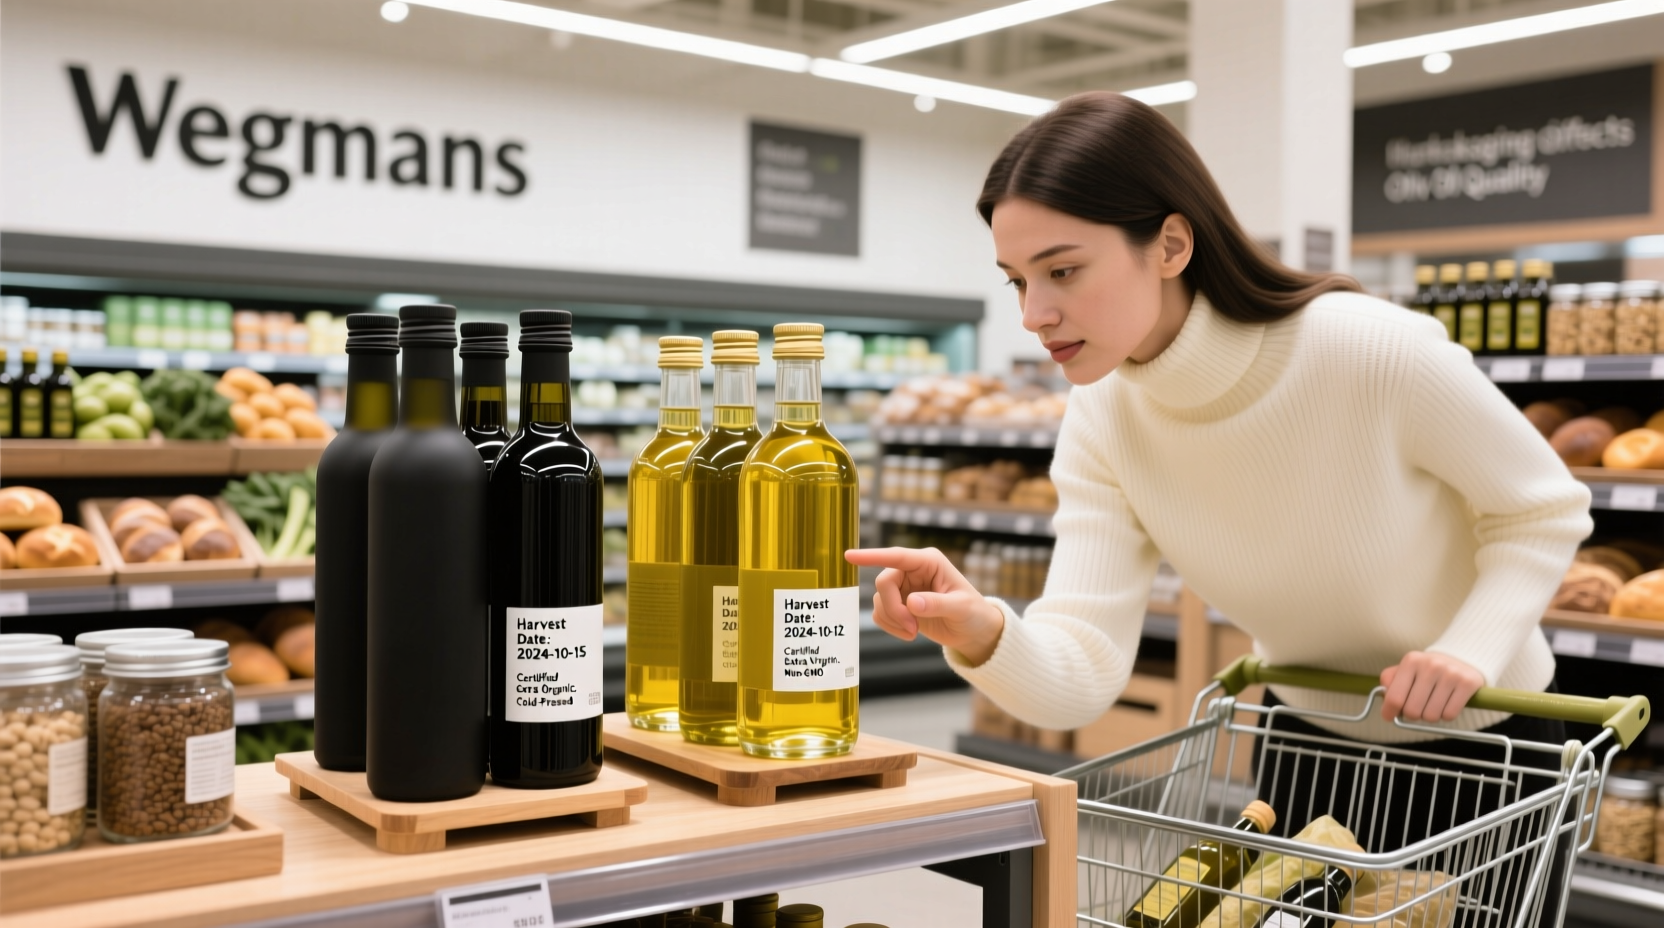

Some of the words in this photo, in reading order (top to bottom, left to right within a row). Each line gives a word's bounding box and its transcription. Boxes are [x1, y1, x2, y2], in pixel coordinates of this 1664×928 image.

[68, 65, 528, 200] Wegmans
[784, 598, 829, 610] Harvest
[517, 618, 567, 630] Harvest
[784, 613, 815, 623] Date:
[784, 625, 845, 638] 2024-10-12
[517, 633, 551, 645] Date:
[517, 645, 587, 660] 2024-10-15
